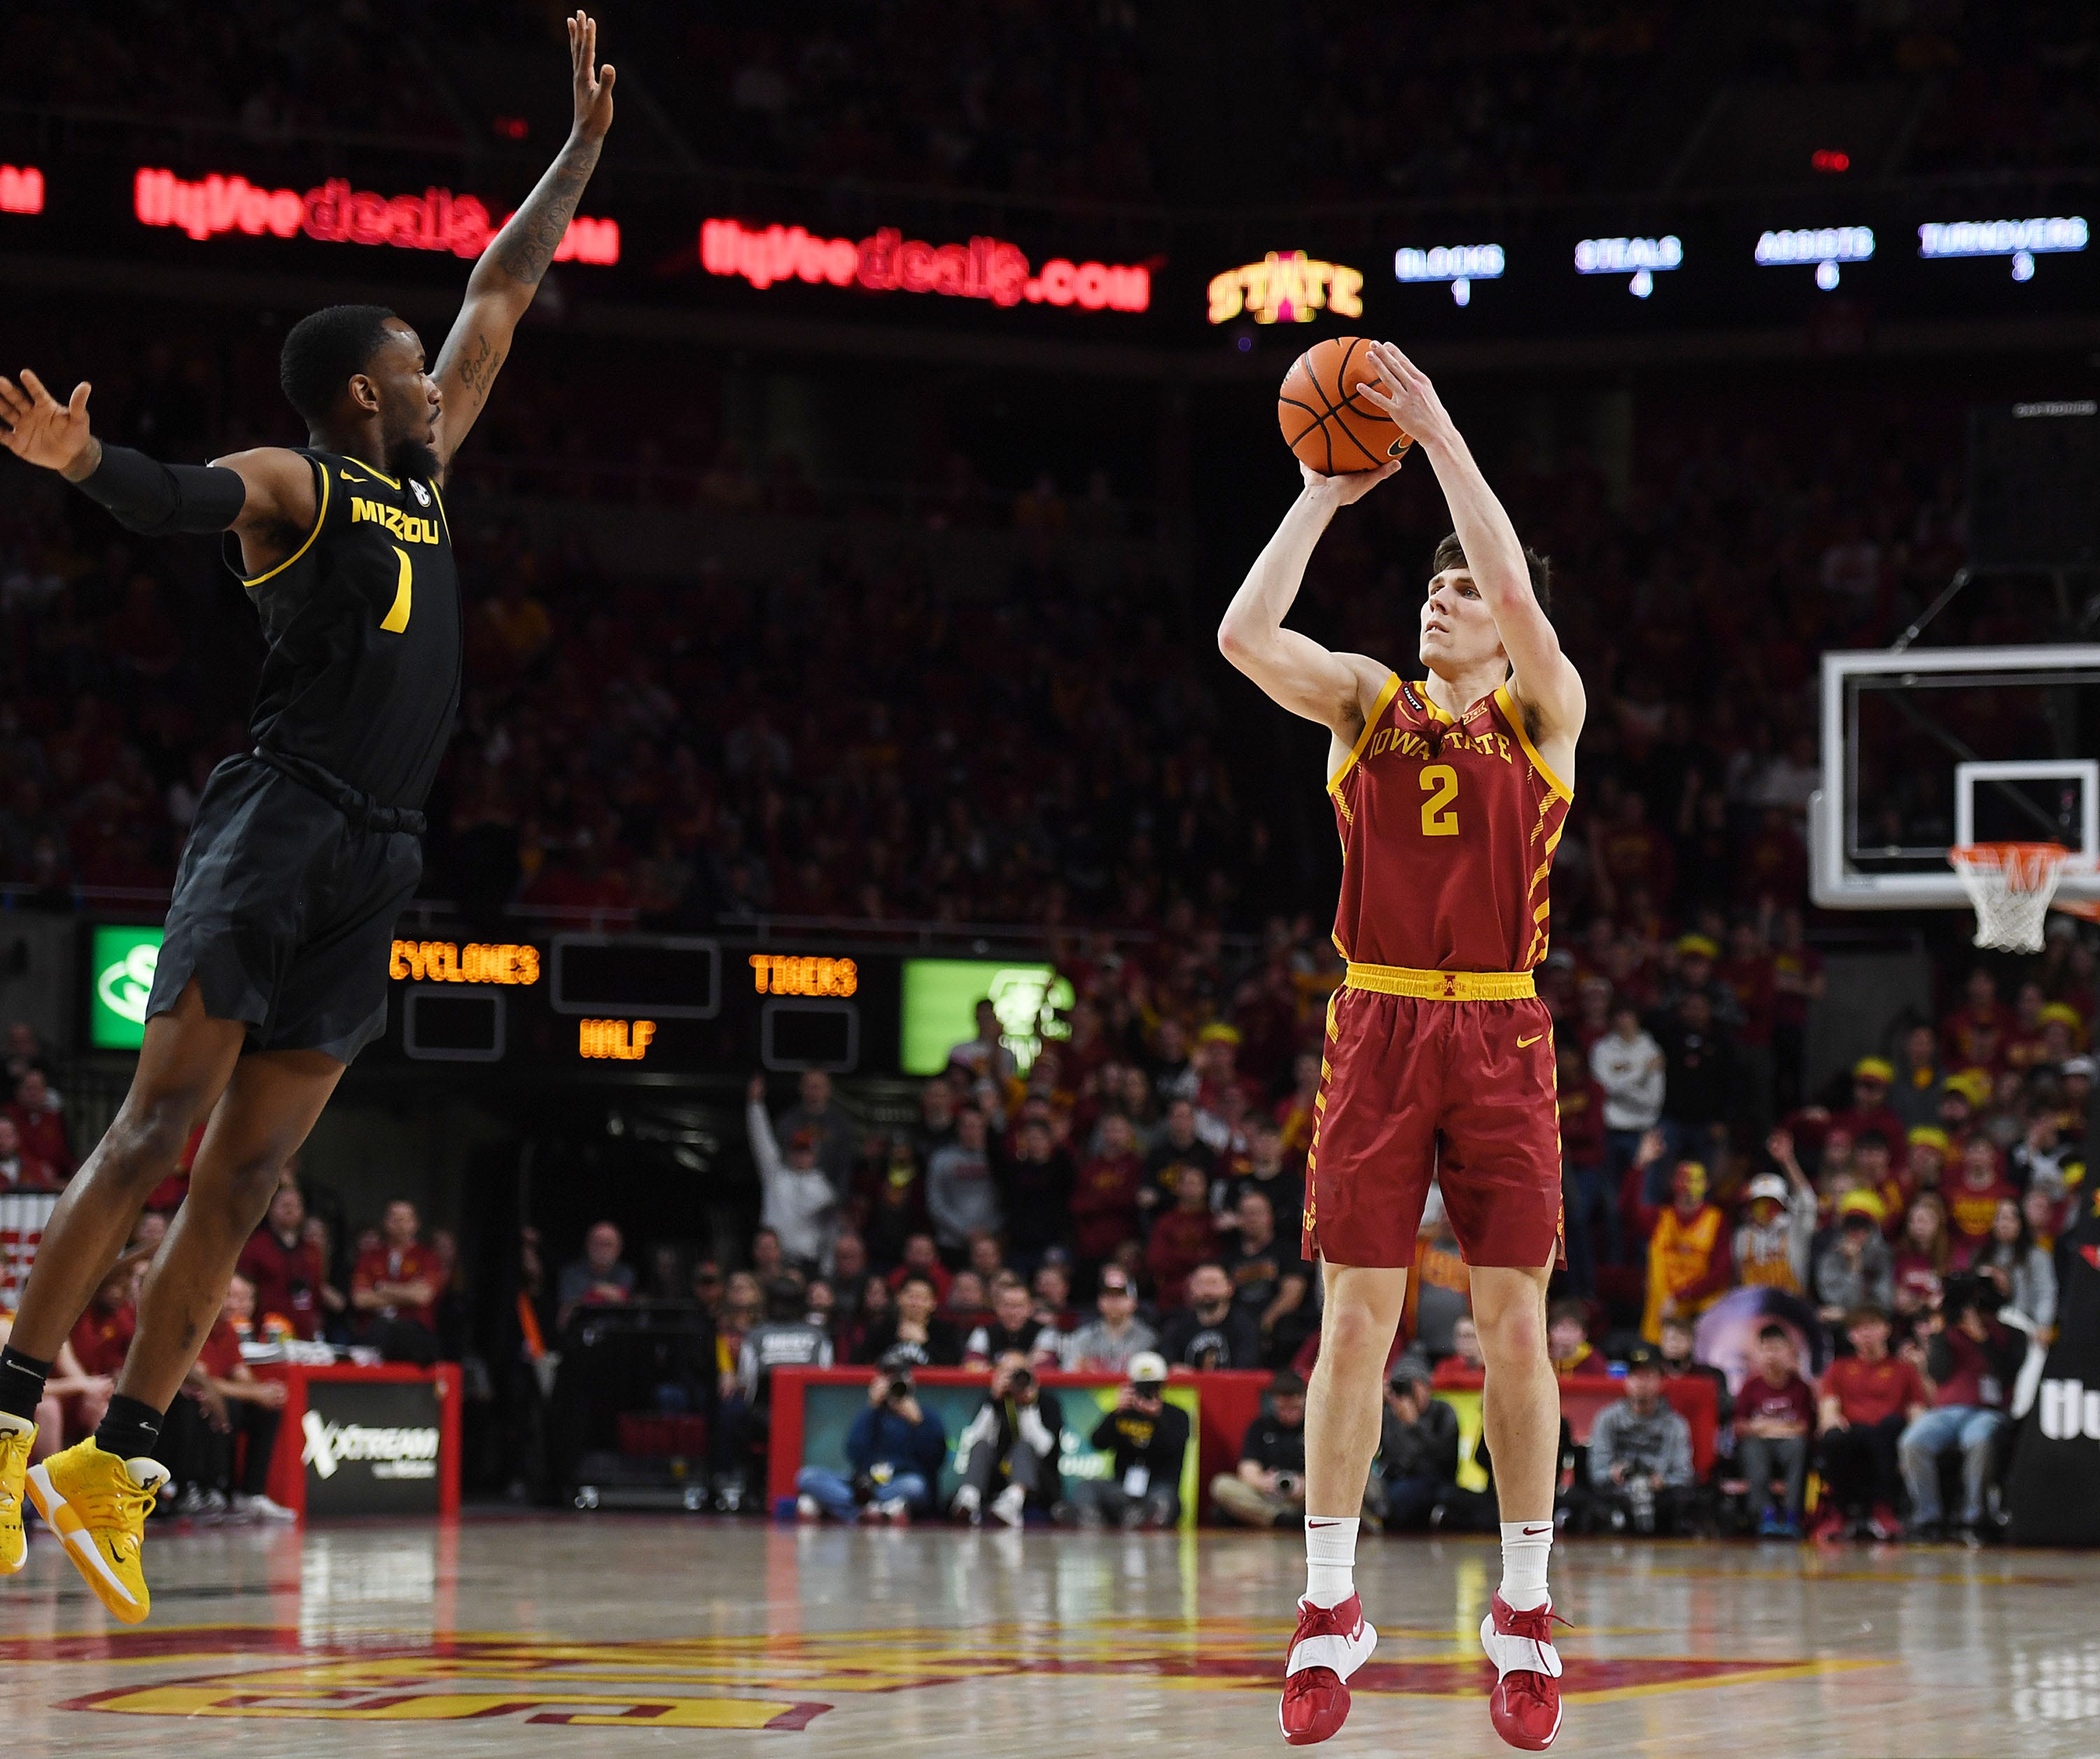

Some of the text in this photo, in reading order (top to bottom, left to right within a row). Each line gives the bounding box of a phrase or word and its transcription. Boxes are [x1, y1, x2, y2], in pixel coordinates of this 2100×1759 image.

[1208, 251, 1363, 325] STATE
[351, 496, 440, 545] MIZZOU
[379, 545, 413, 634] 1
[1403, 686, 1423, 710] UNITY
[1368, 727, 1430, 761] IOWA
[1418, 764, 1460, 836] 2
[389, 939, 540, 986] CYCLONES
[749, 954, 858, 997] TIGERS
[580, 1018, 657, 1060] HALF
